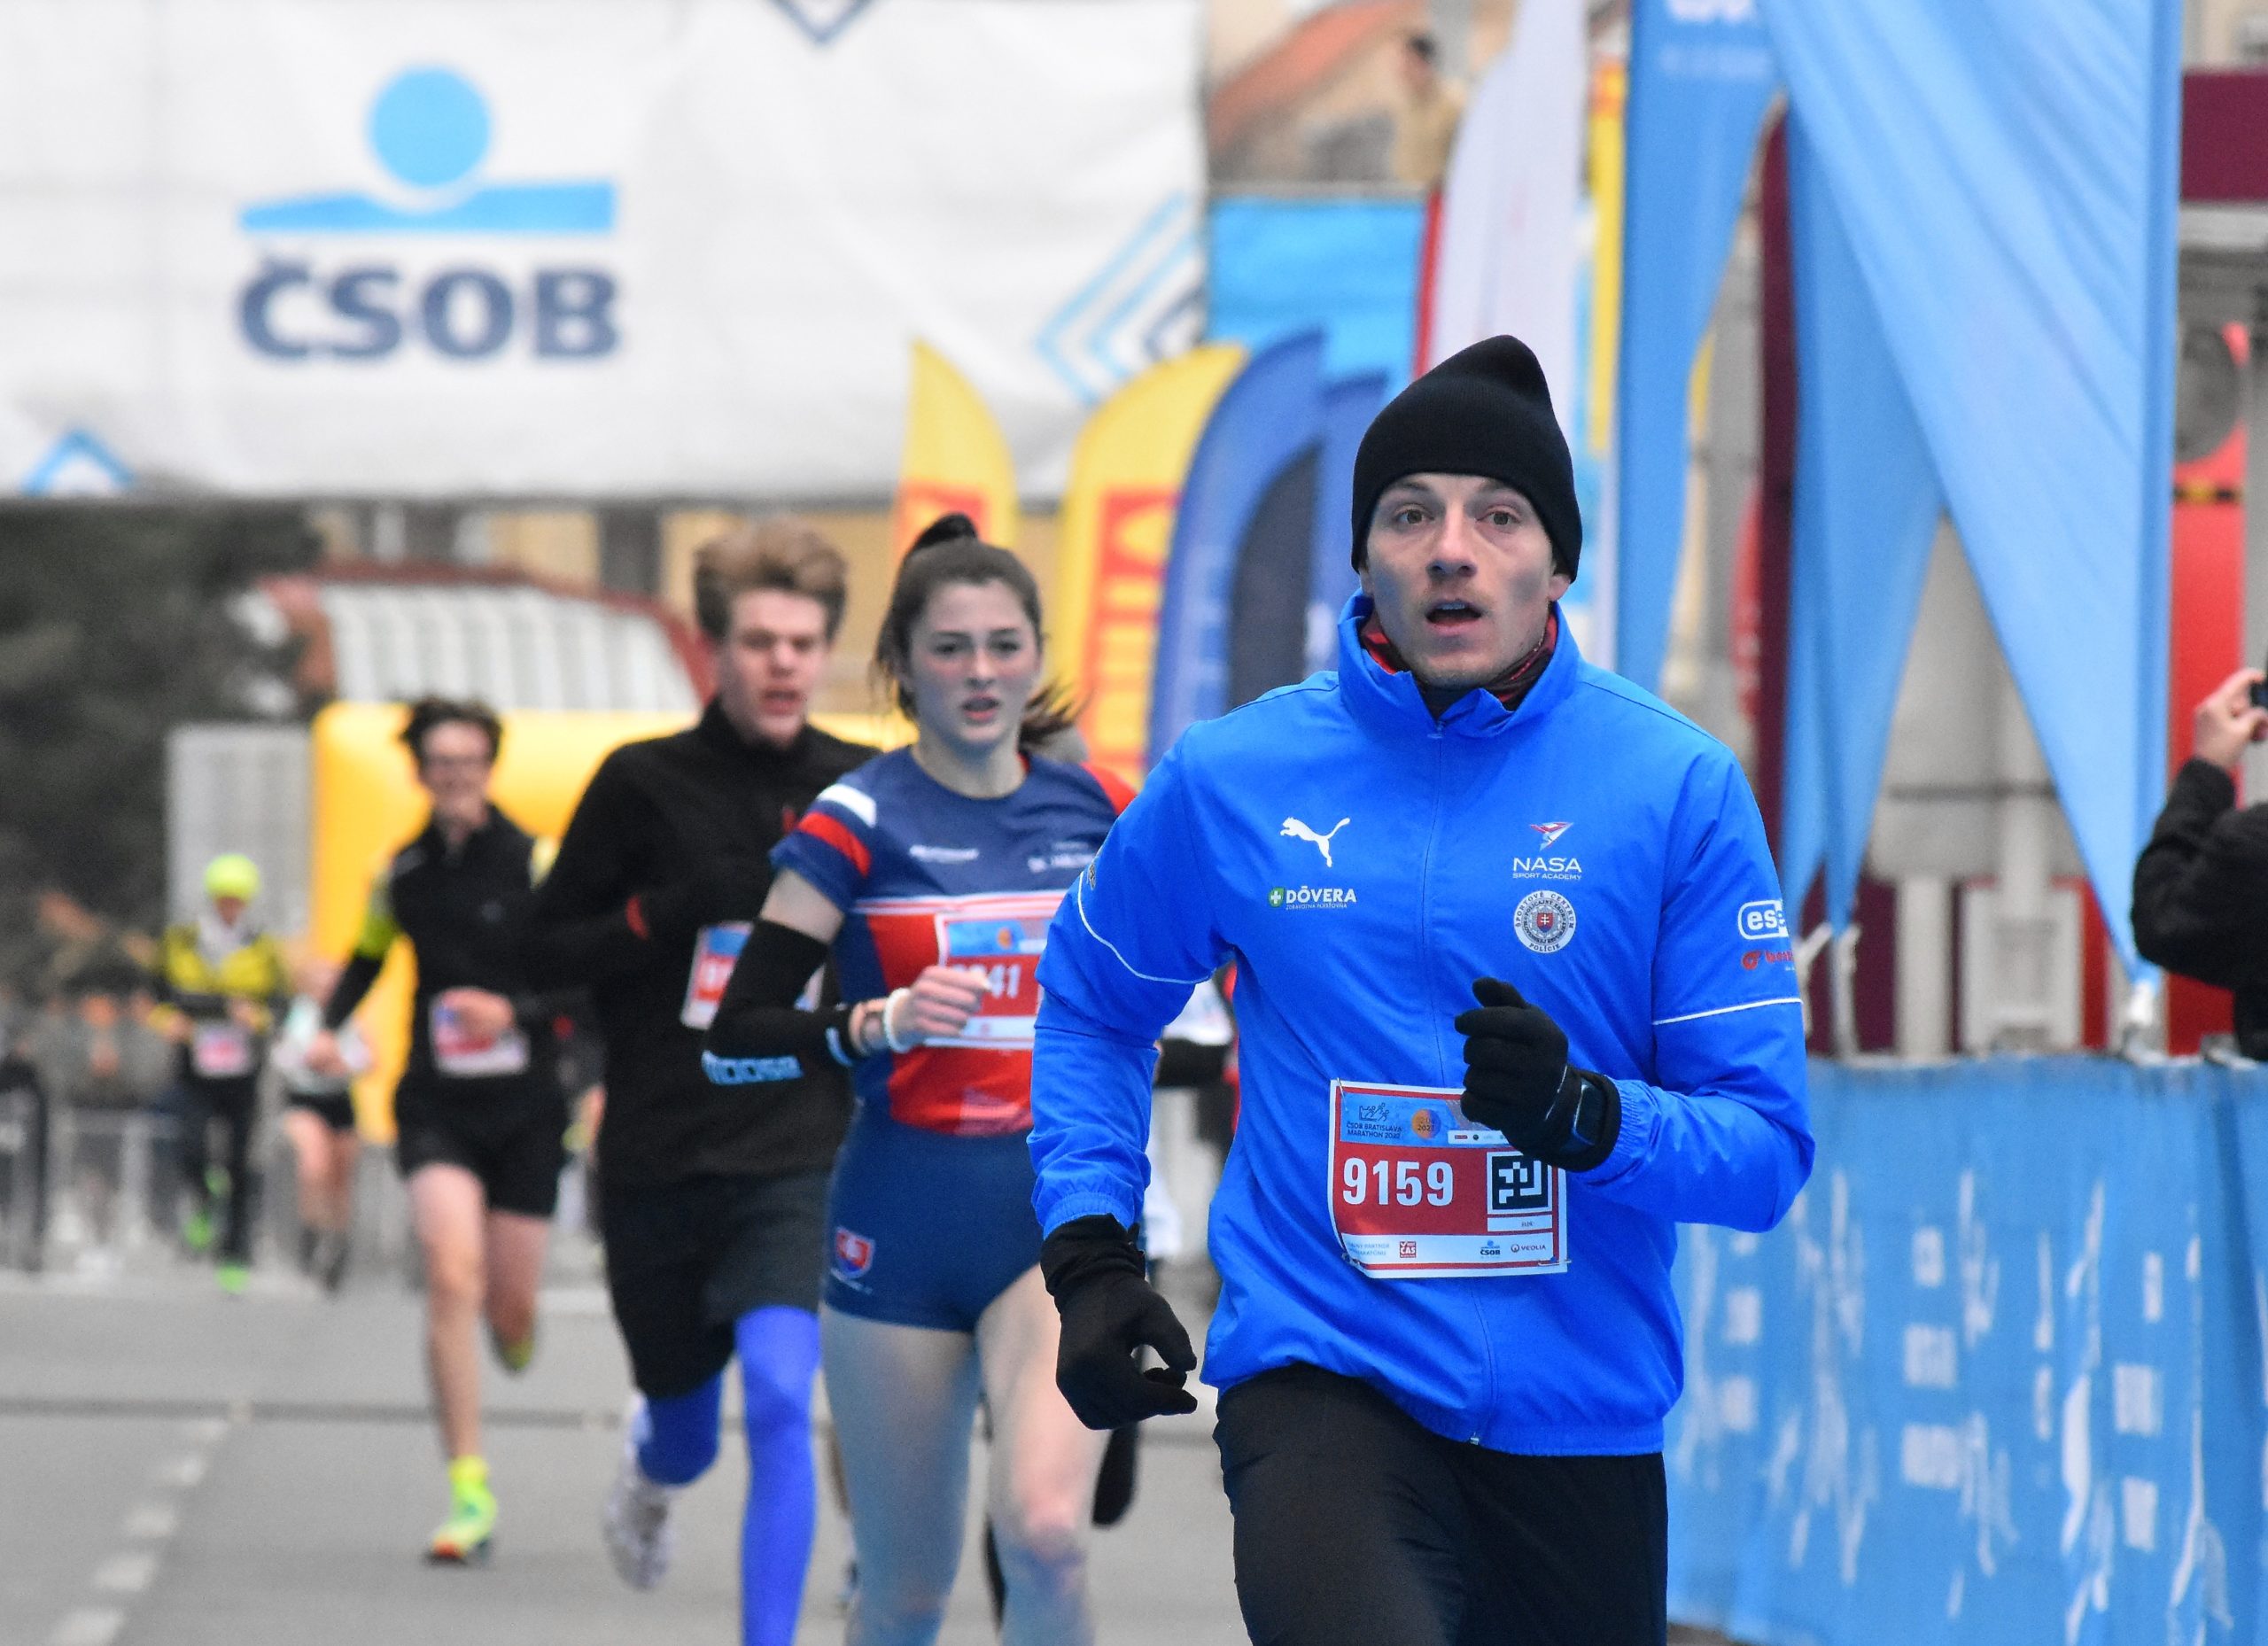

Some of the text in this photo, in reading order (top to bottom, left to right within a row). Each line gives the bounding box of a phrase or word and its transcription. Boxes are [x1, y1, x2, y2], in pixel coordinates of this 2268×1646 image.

[242, 256, 618, 361] ČSOB
[1513, 857, 1582, 873] NASA
[1550, 893, 1574, 928] CENTRUM
[1347, 1130, 1384, 1138] MARATHON
[1364, 1122, 1402, 1132] BRATISLAVA
[1343, 1157, 1454, 1207] 9159
